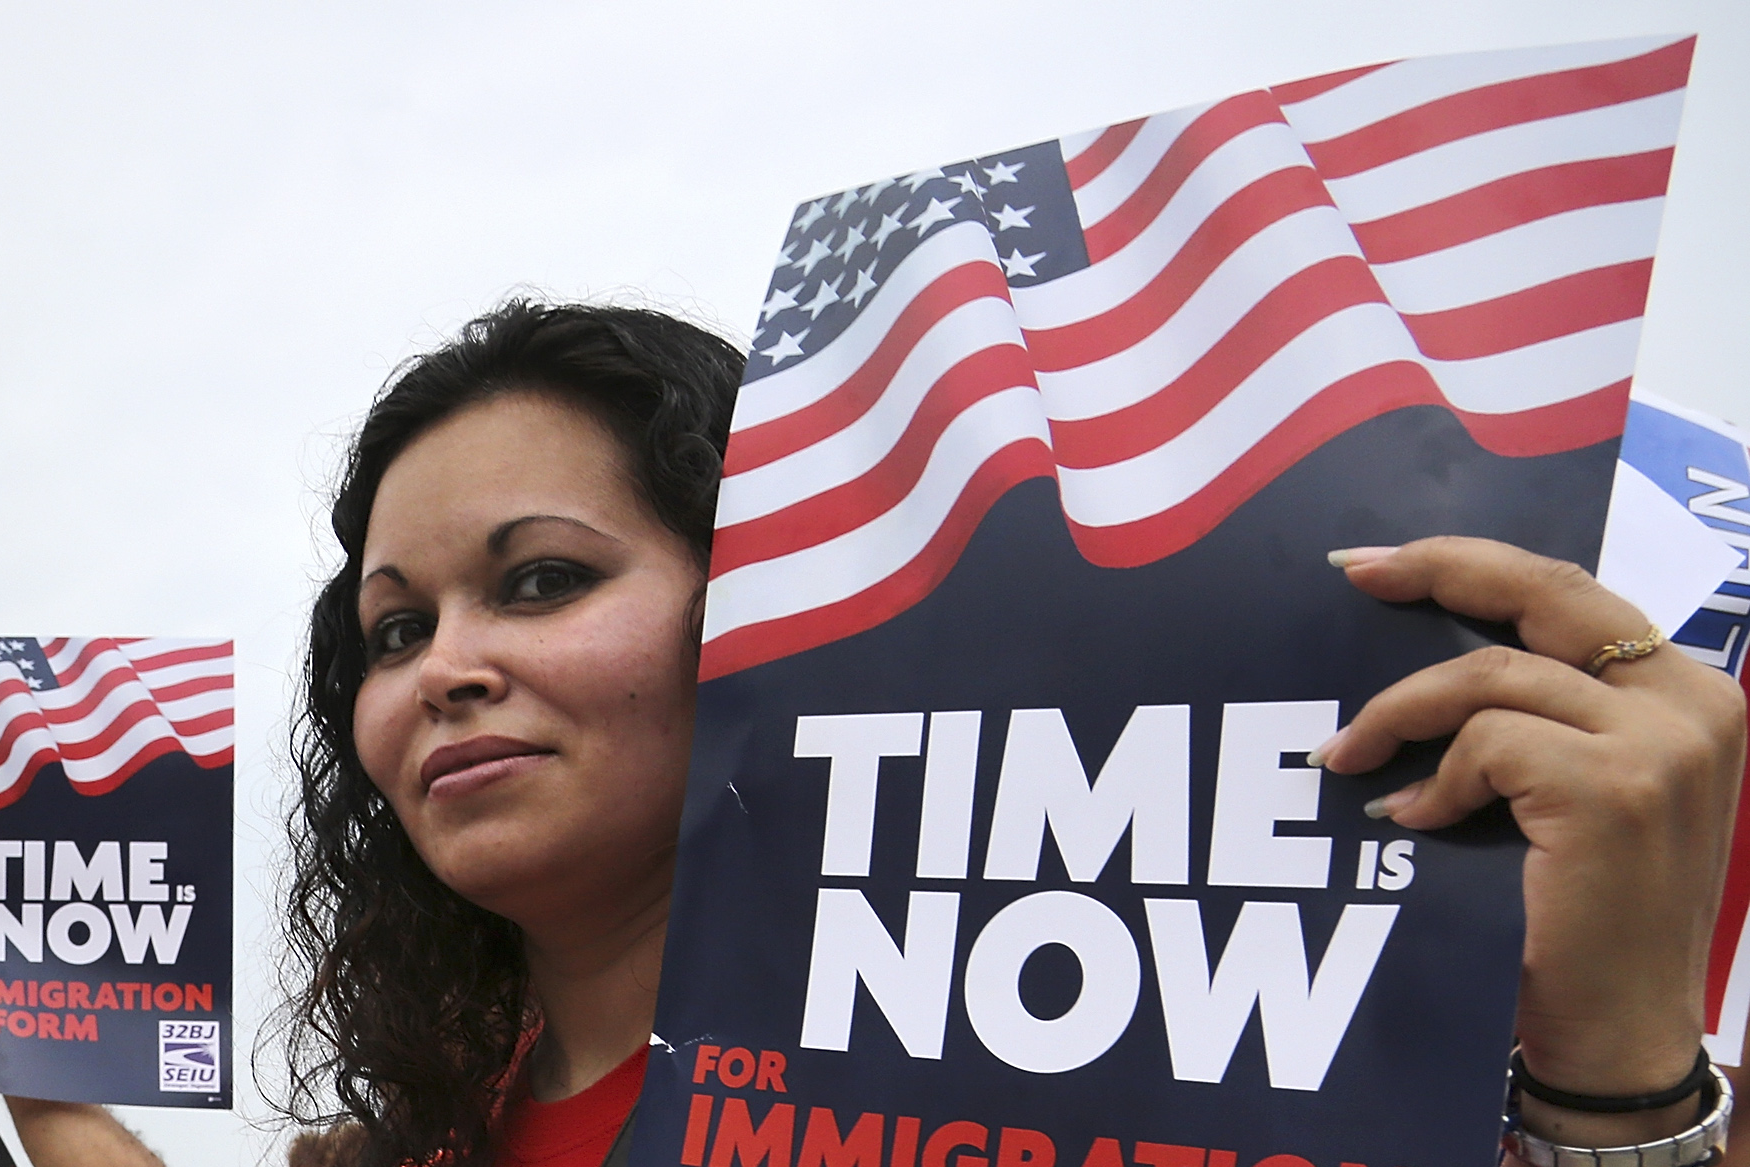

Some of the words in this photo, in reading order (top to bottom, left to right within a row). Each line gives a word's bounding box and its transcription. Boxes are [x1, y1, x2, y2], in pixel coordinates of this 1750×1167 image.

[793, 700, 1340, 889] TIME
[1356, 840, 1416, 891] IS
[176, 884, 197, 903] IS
[800, 887, 1401, 1092] NOW
[162, 1024, 216, 1040] 32BJ
[163, 1067, 216, 1082] SEIU
[692, 1044, 788, 1093] FOR
